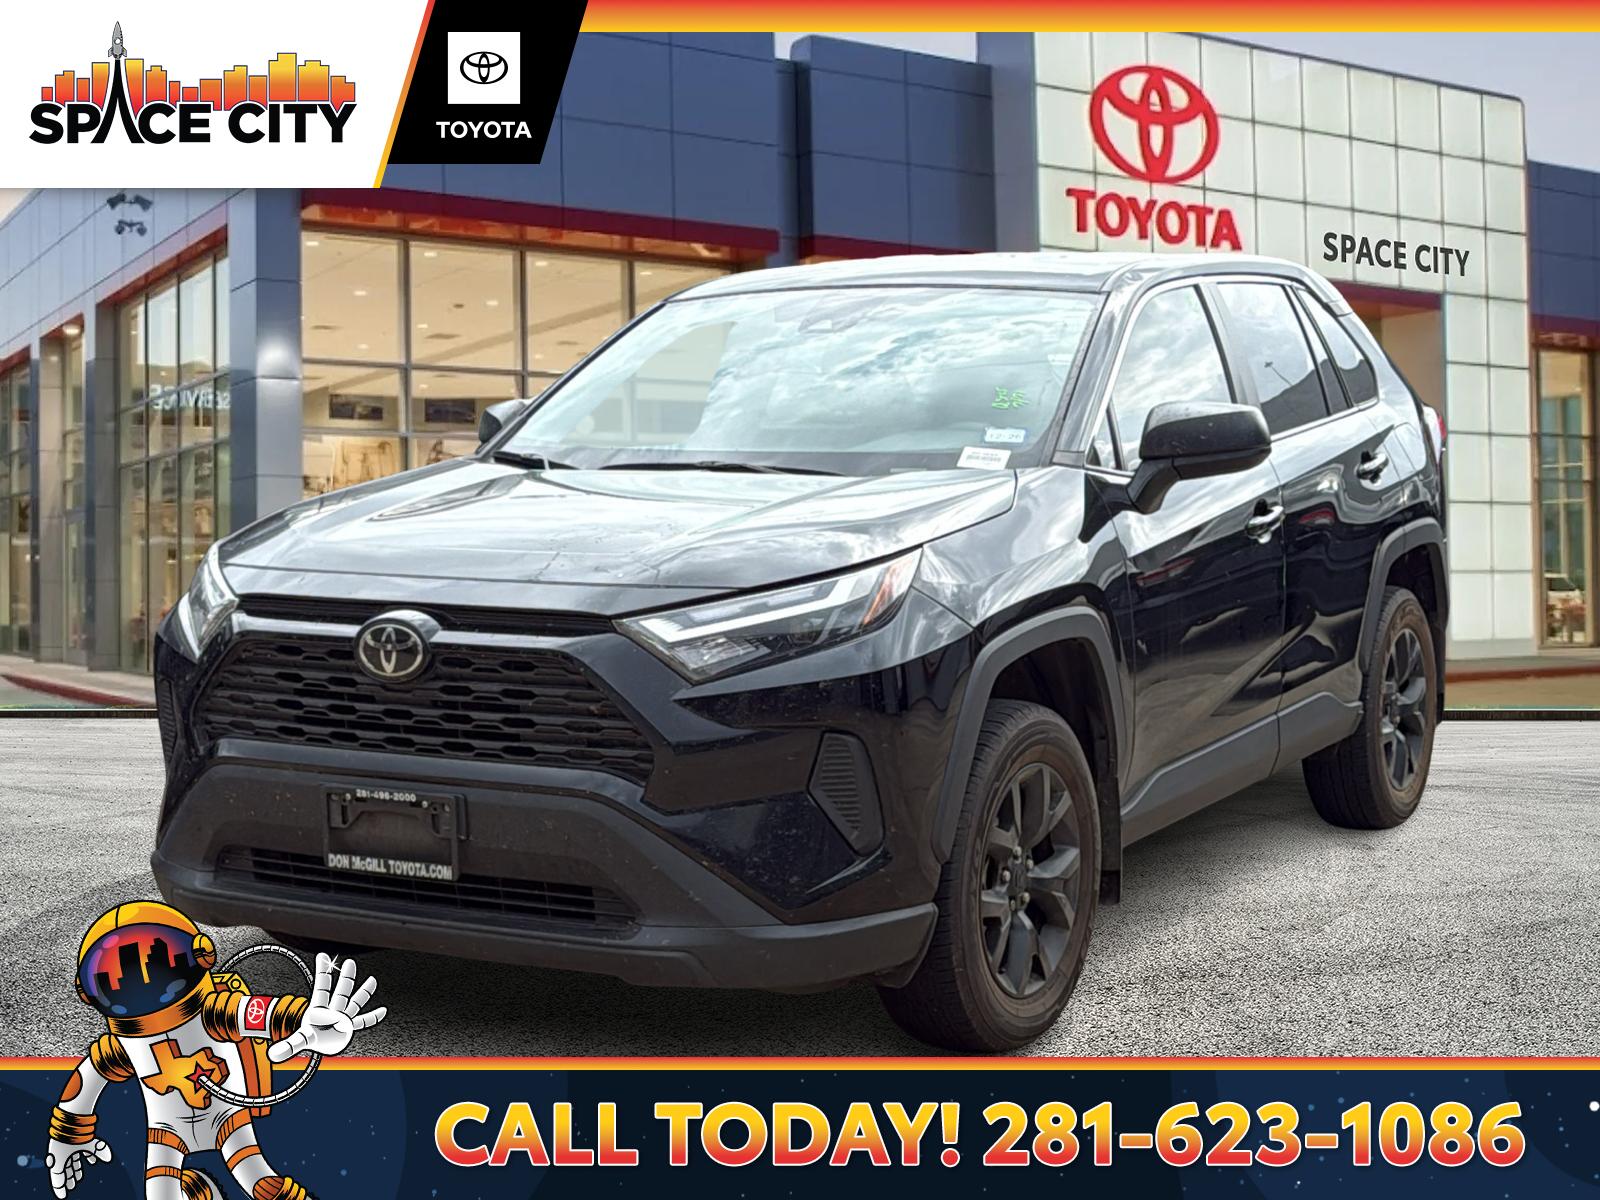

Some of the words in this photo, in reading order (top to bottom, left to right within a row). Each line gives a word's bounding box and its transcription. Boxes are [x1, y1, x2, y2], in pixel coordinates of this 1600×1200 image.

[1066, 188, 1242, 251] TOYOTA
[1323, 231, 1407, 269] SPACE
[1414, 244, 1470, 277] CITY
[328, 853, 350, 869] DON
[352, 856, 387, 873] McGILL
[388, 860, 453, 880] TOYOTA.COM
